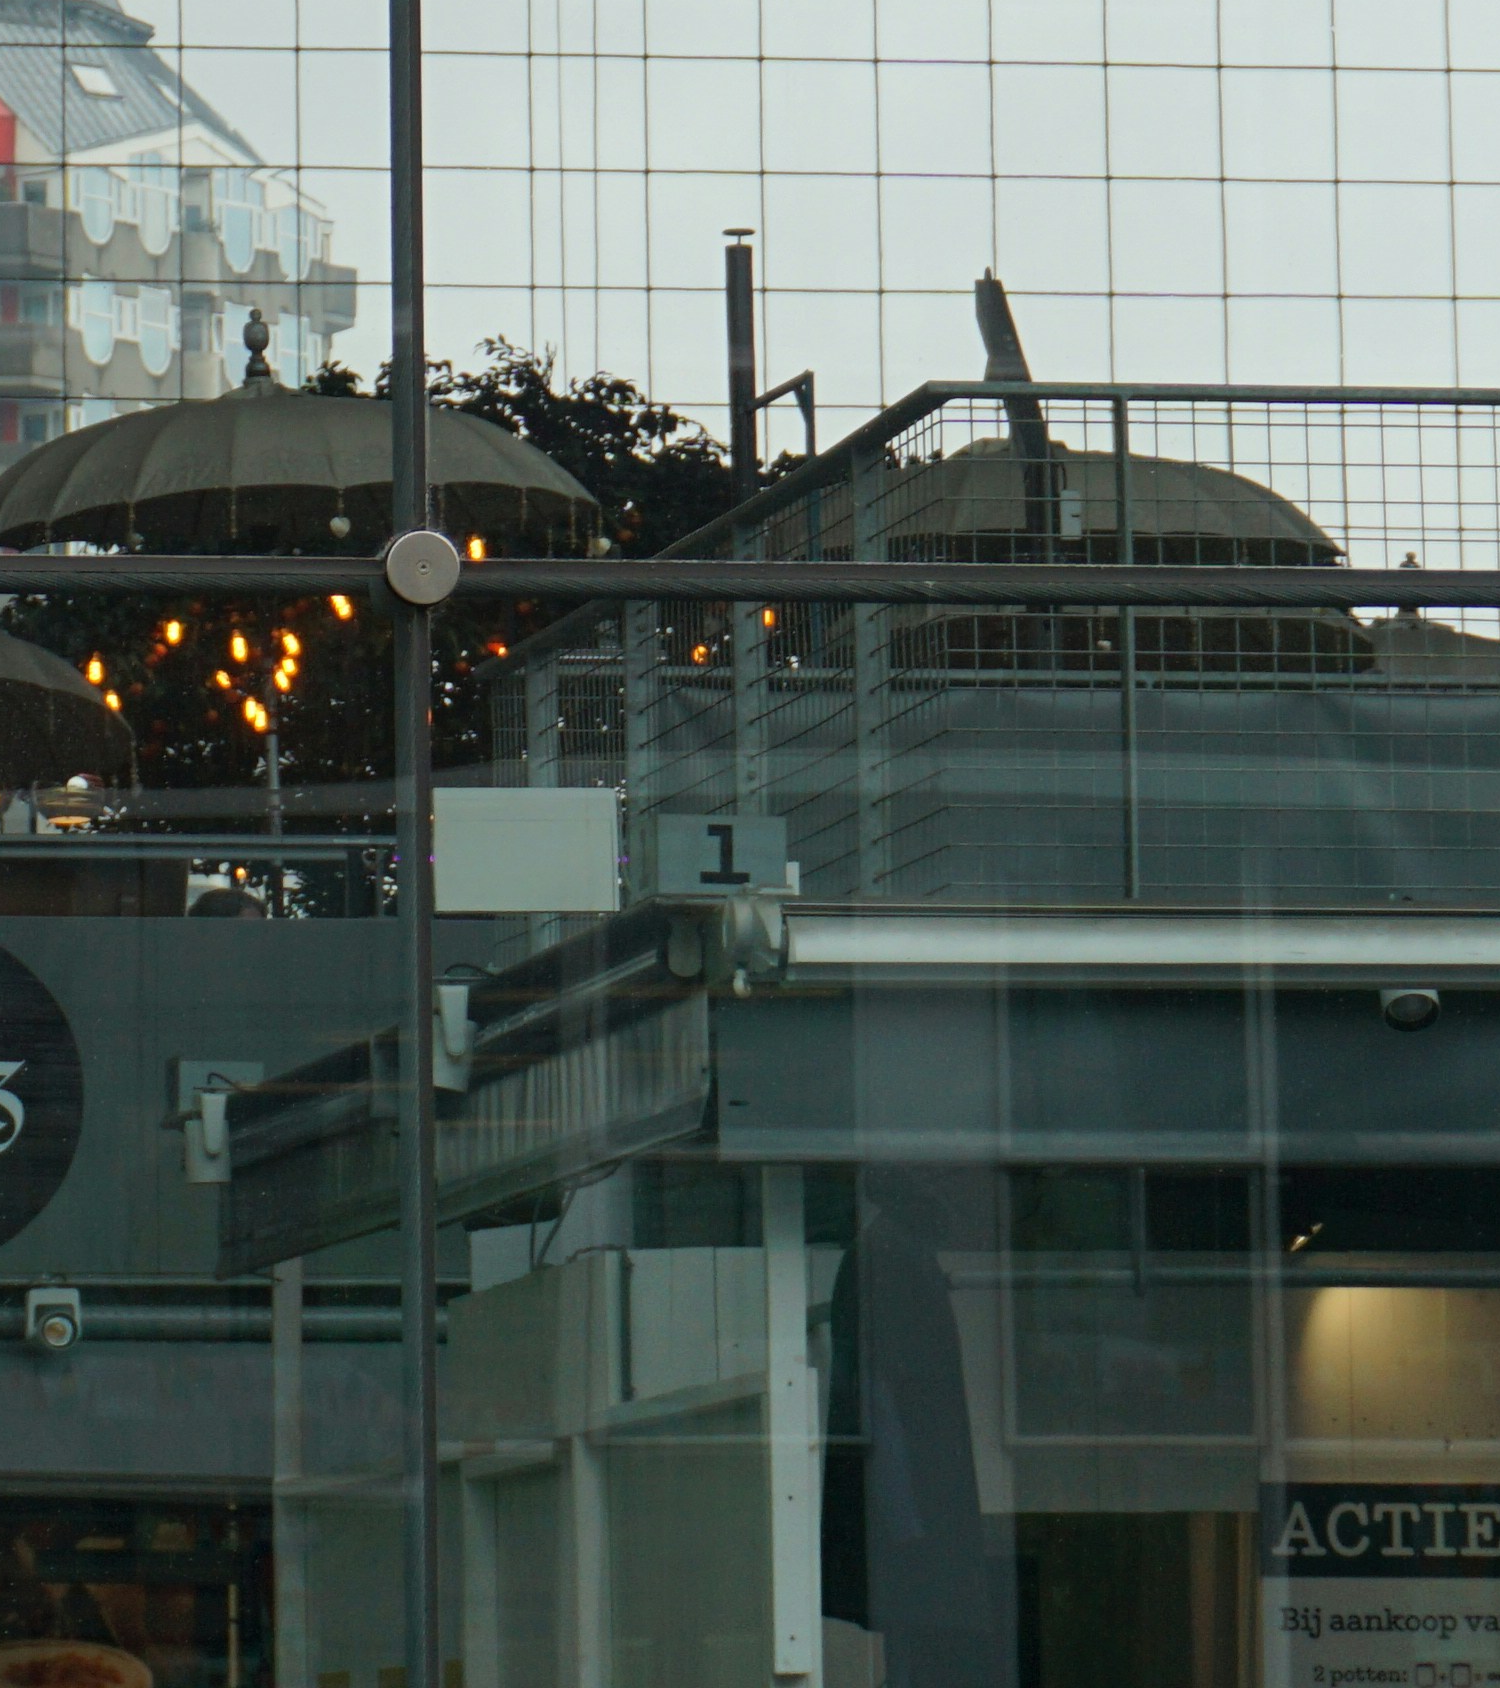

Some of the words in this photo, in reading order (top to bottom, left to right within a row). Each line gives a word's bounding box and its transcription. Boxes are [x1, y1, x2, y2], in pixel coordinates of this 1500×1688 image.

[699, 823, 751, 885] 1
[1280, 1607, 1322, 1640] Bij
[1328, 1607, 1458, 1640] aankoop
[1312, 1665, 1326, 1683] 2
[1329, 1666, 1408, 1688] potten:
